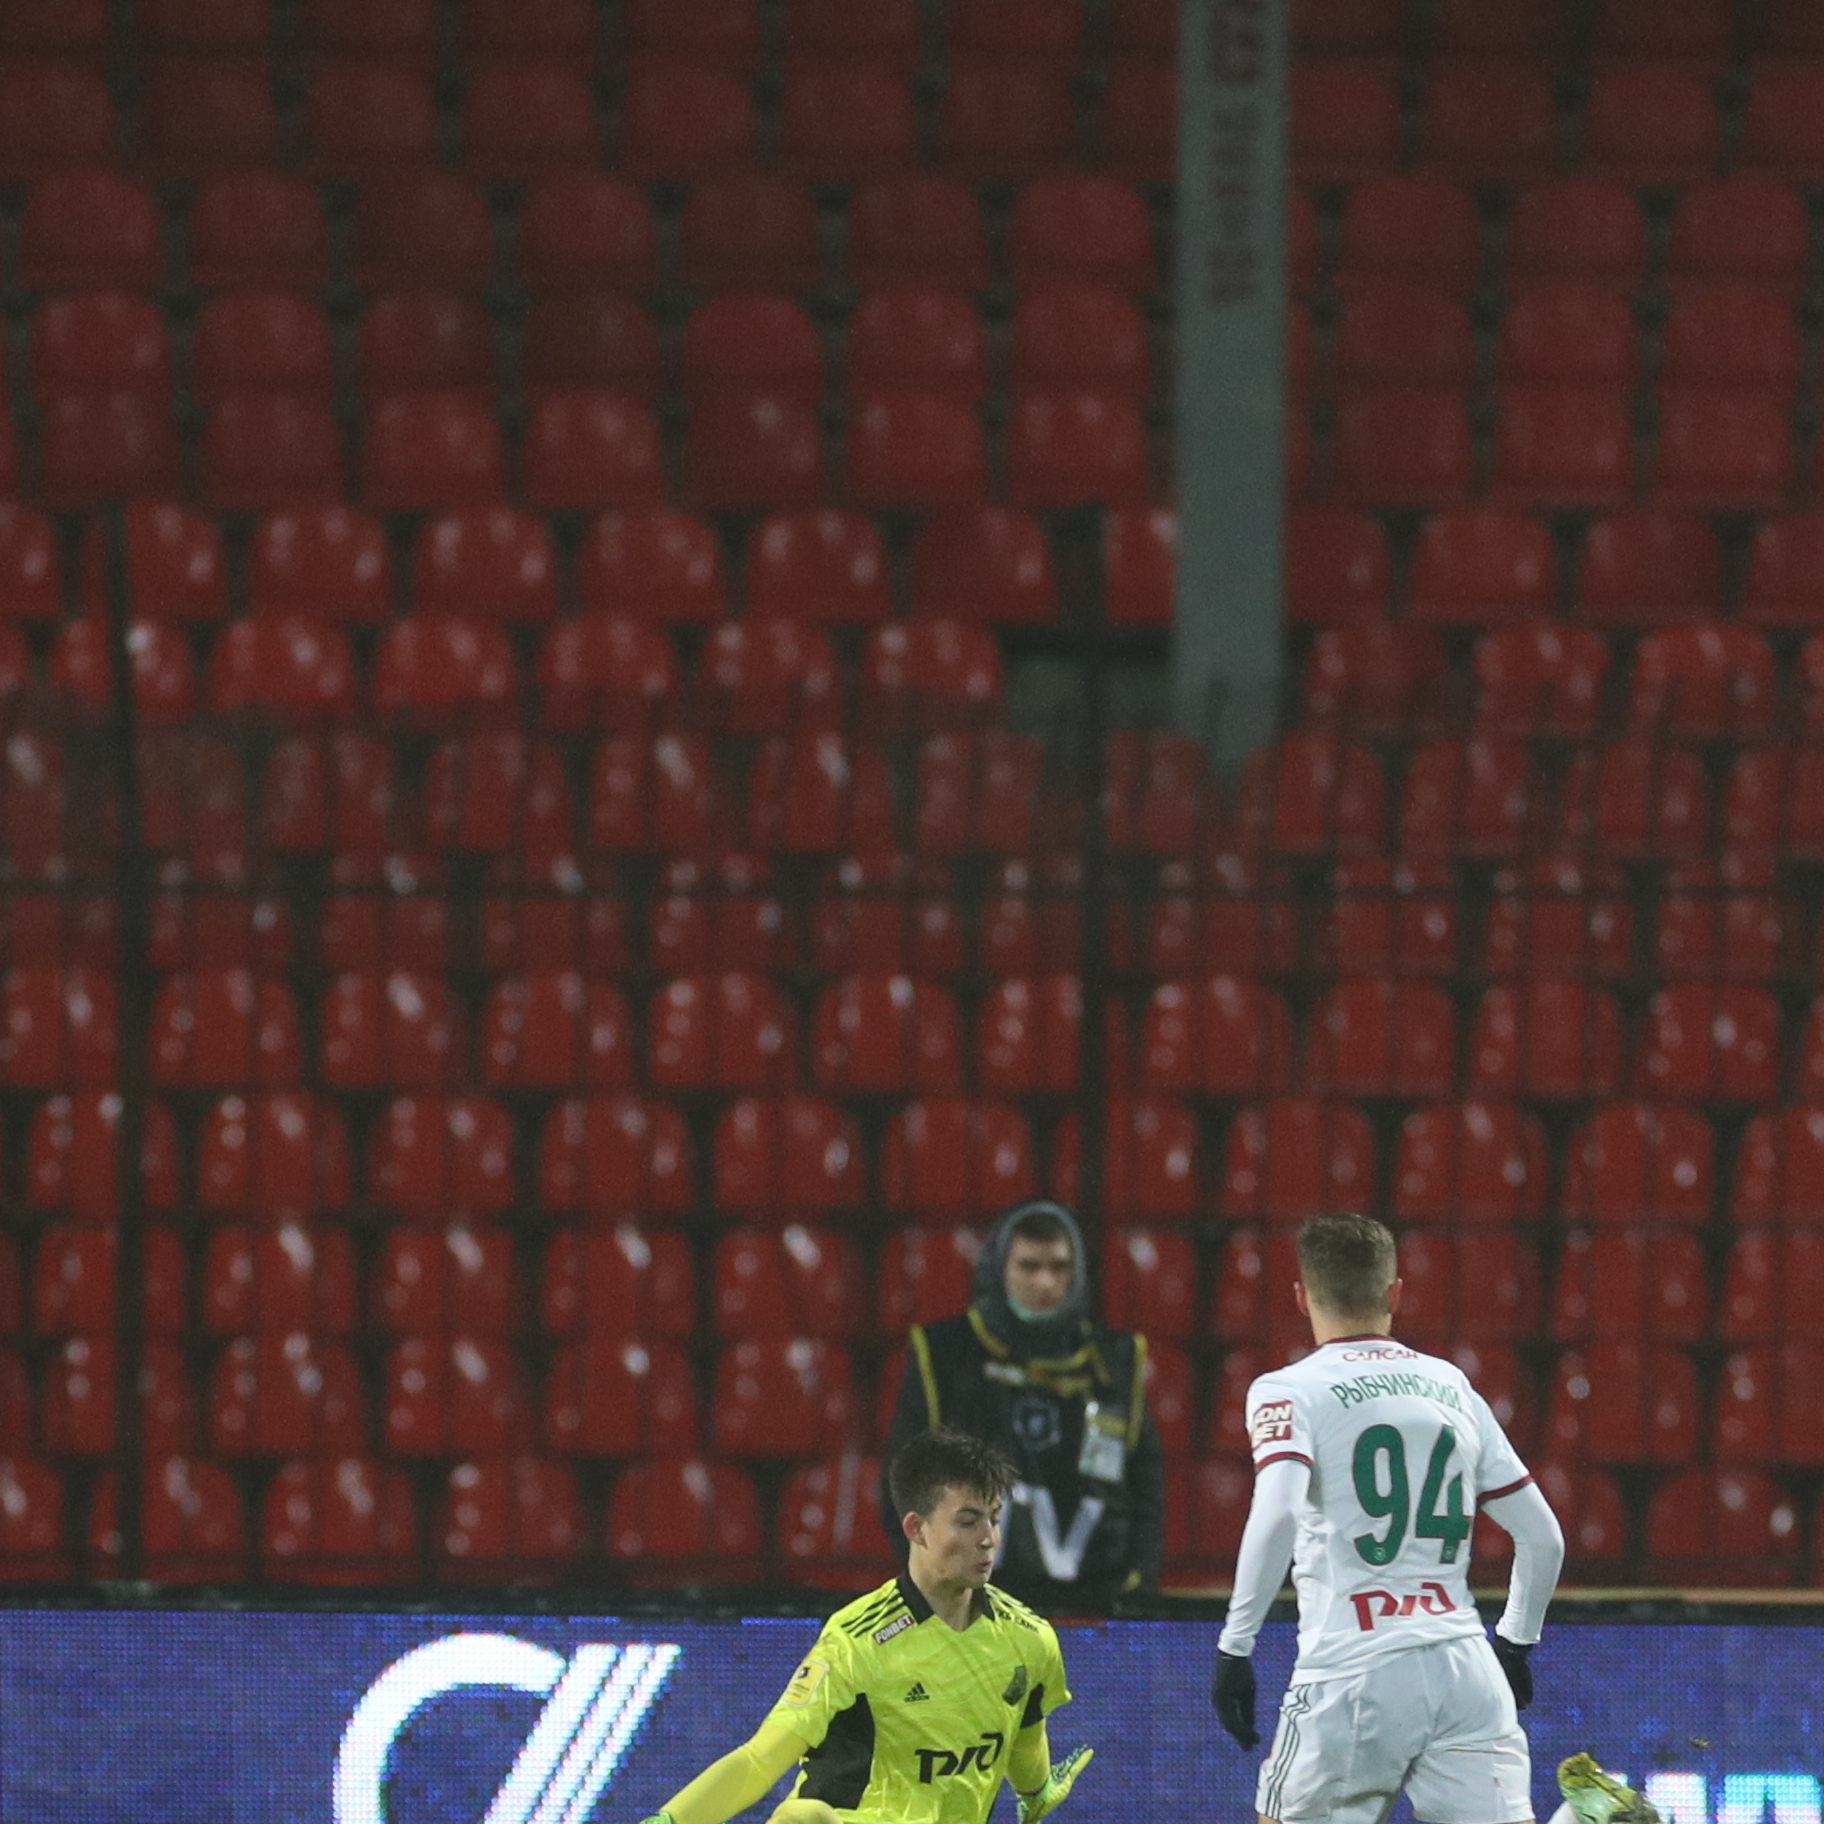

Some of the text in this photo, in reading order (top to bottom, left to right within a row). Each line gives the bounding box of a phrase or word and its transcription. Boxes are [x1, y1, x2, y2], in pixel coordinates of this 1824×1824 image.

[1331, 1374, 1462, 1412] РЫБЧИНСКИЙ
[1352, 1424, 1473, 1566] 94
[875, 1614, 913, 1644] FONBET
